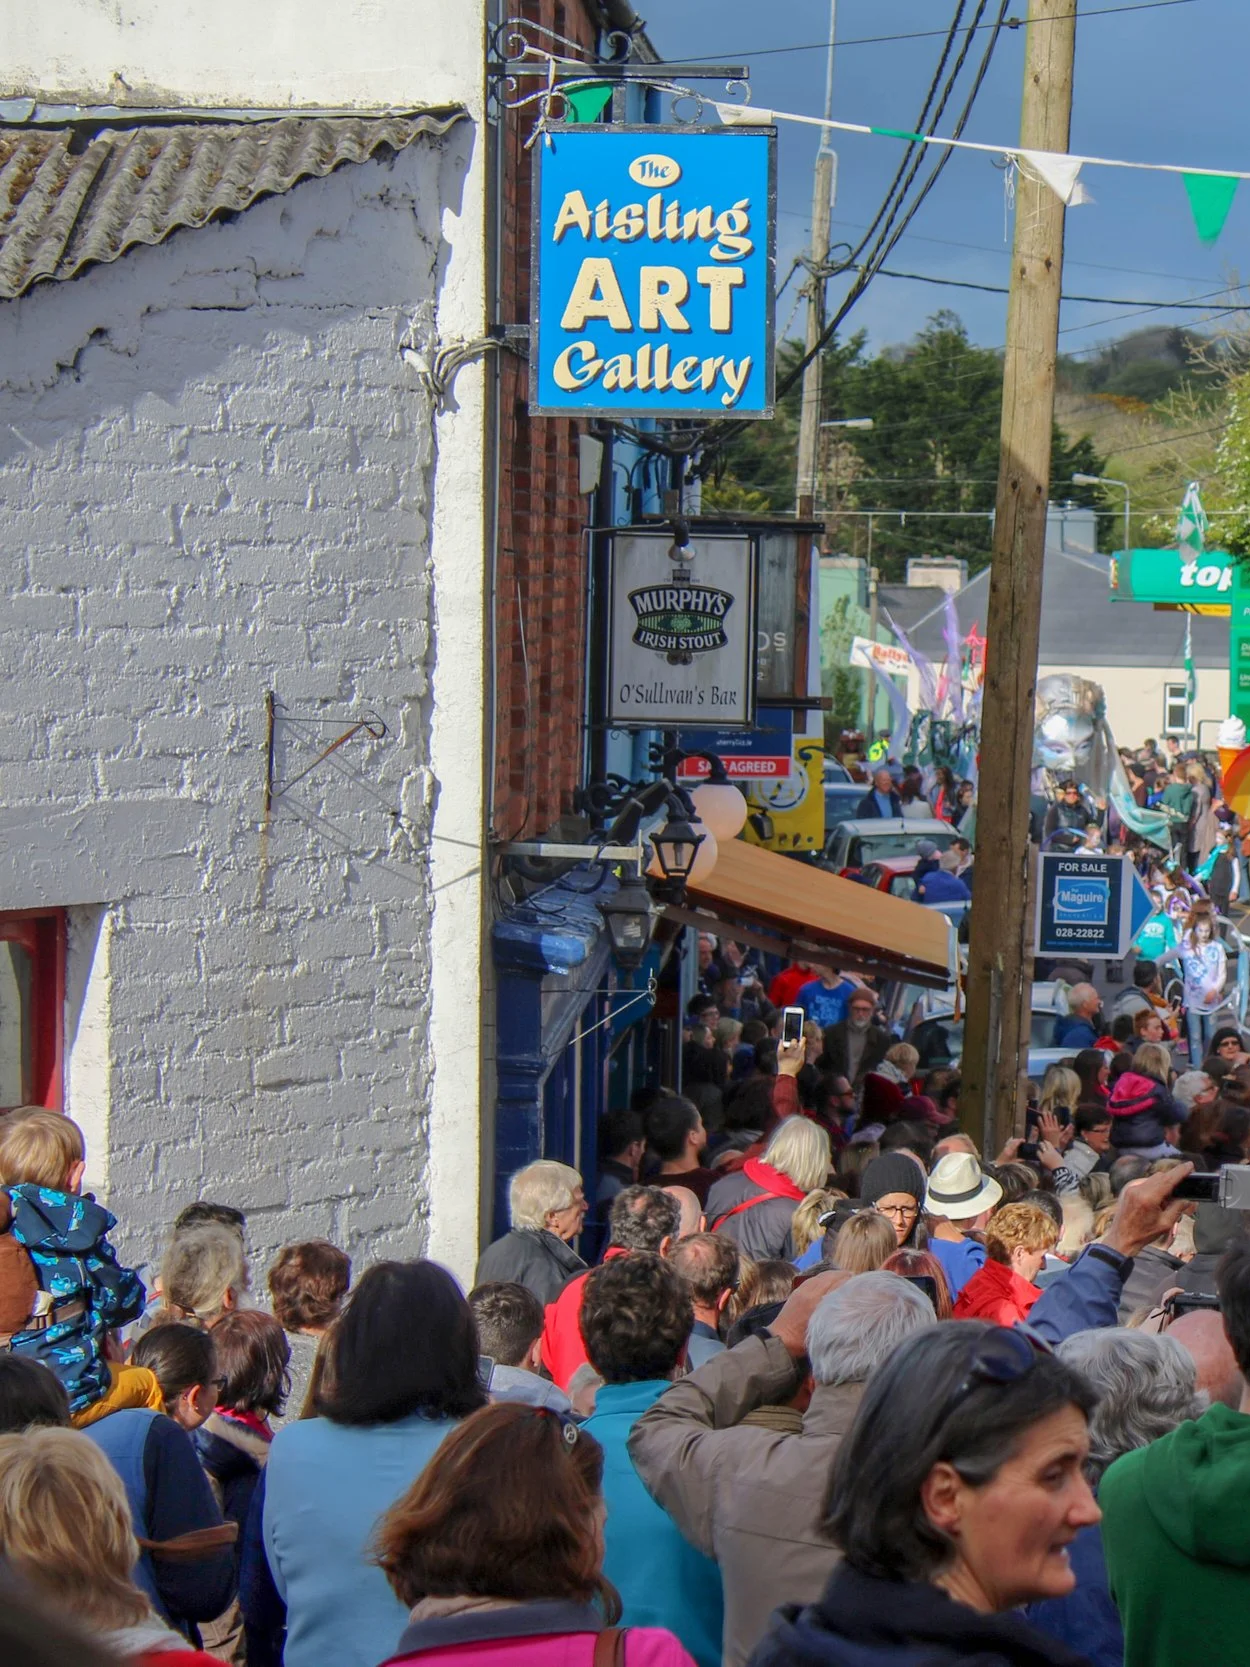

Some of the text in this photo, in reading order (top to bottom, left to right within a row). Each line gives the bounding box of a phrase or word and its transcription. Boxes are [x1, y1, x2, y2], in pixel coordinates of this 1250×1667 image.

[637, 160, 671, 178] The
[552, 190, 754, 261] Aisling
[560, 257, 745, 332] ART
[552, 340, 752, 407] Gallery
[633, 589, 727, 616] MURPHY'S
[640, 631, 721, 649] IRISH STOUT
[698, 761, 777, 773] SAE AGREED
[1058, 862, 1108, 873] FOR SALE
[1060, 890, 1104, 904] Maguire
